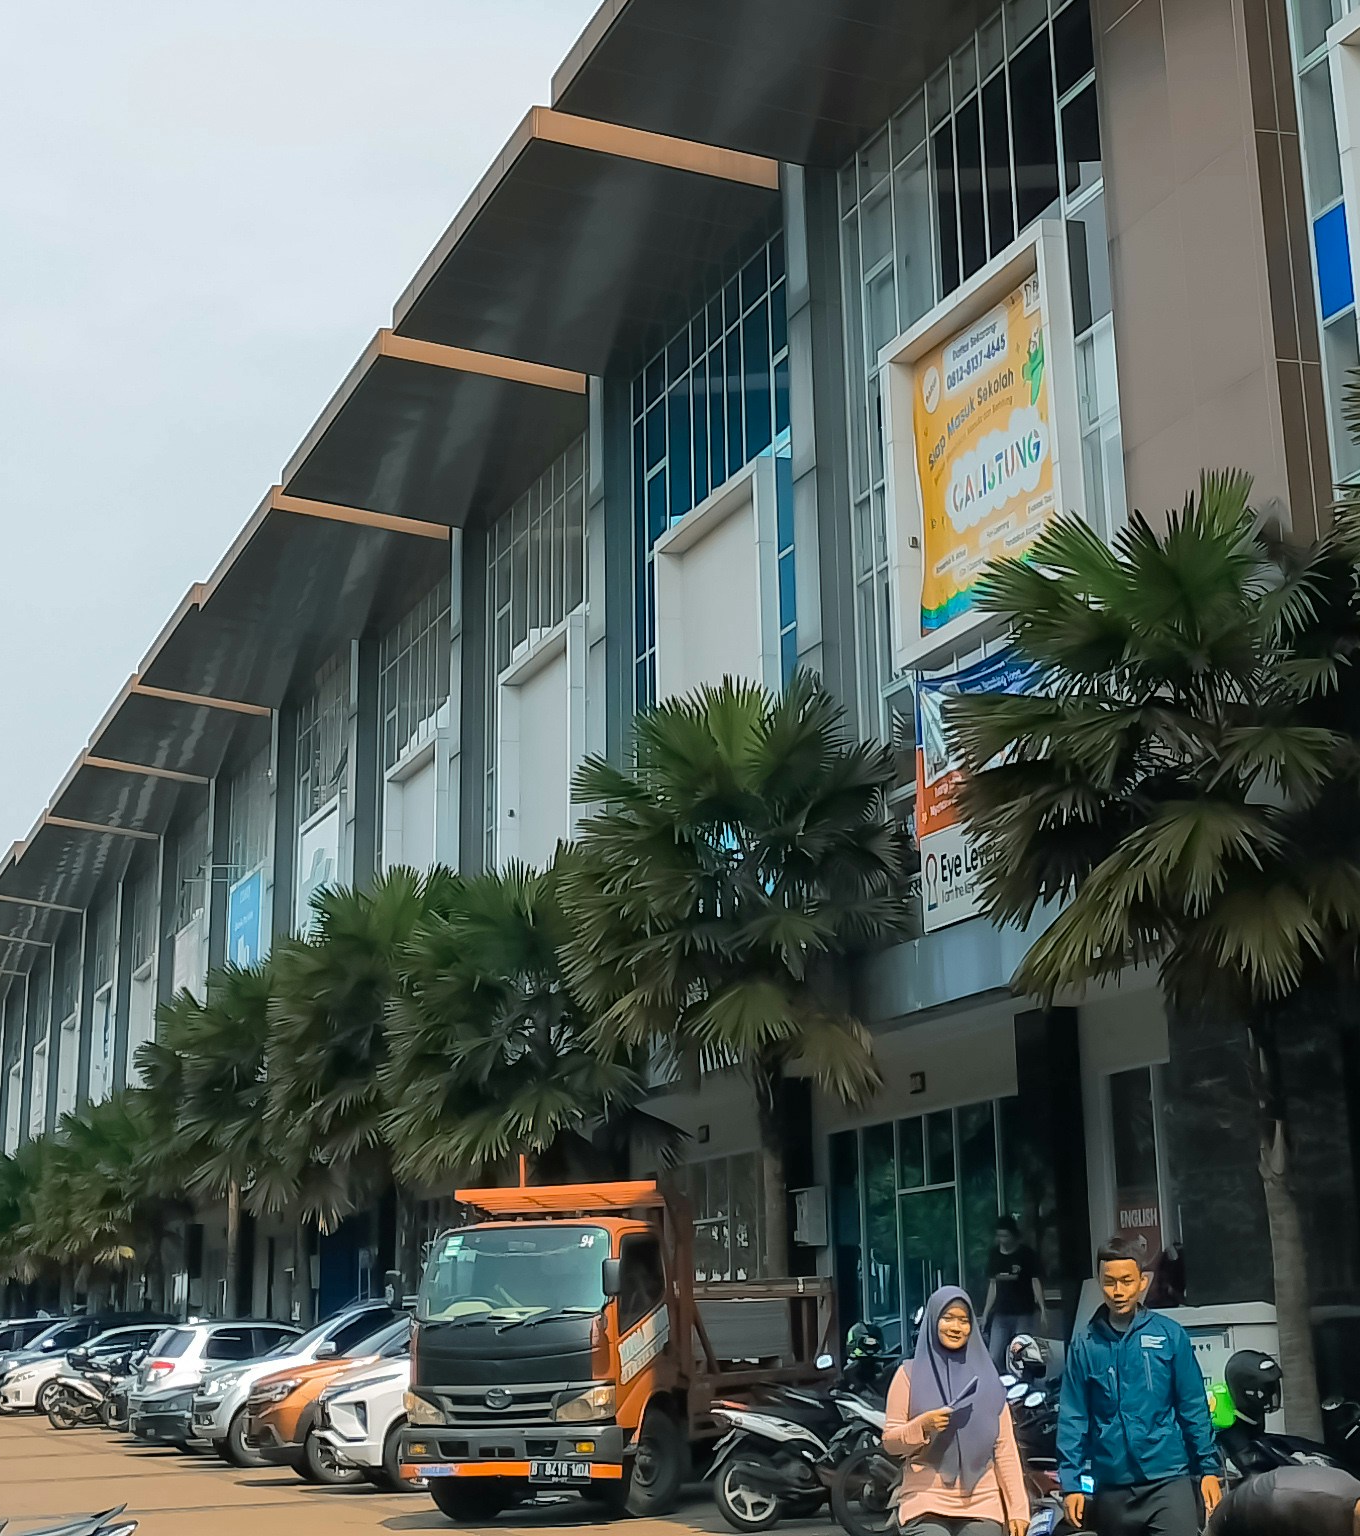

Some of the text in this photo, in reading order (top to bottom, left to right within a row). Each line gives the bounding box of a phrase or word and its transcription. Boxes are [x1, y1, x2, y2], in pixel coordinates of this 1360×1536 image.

[929, 435, 946, 472] Siap
[947, 396, 976, 440] Masuk
[977, 368, 1014, 406] Sekolah
[952, 429, 1041, 512] CALISTUNG
[941, 853, 962, 887] Eye
[1120, 1207, 1158, 1229] ENGLISH
[580, 1234, 595, 1248] 94
